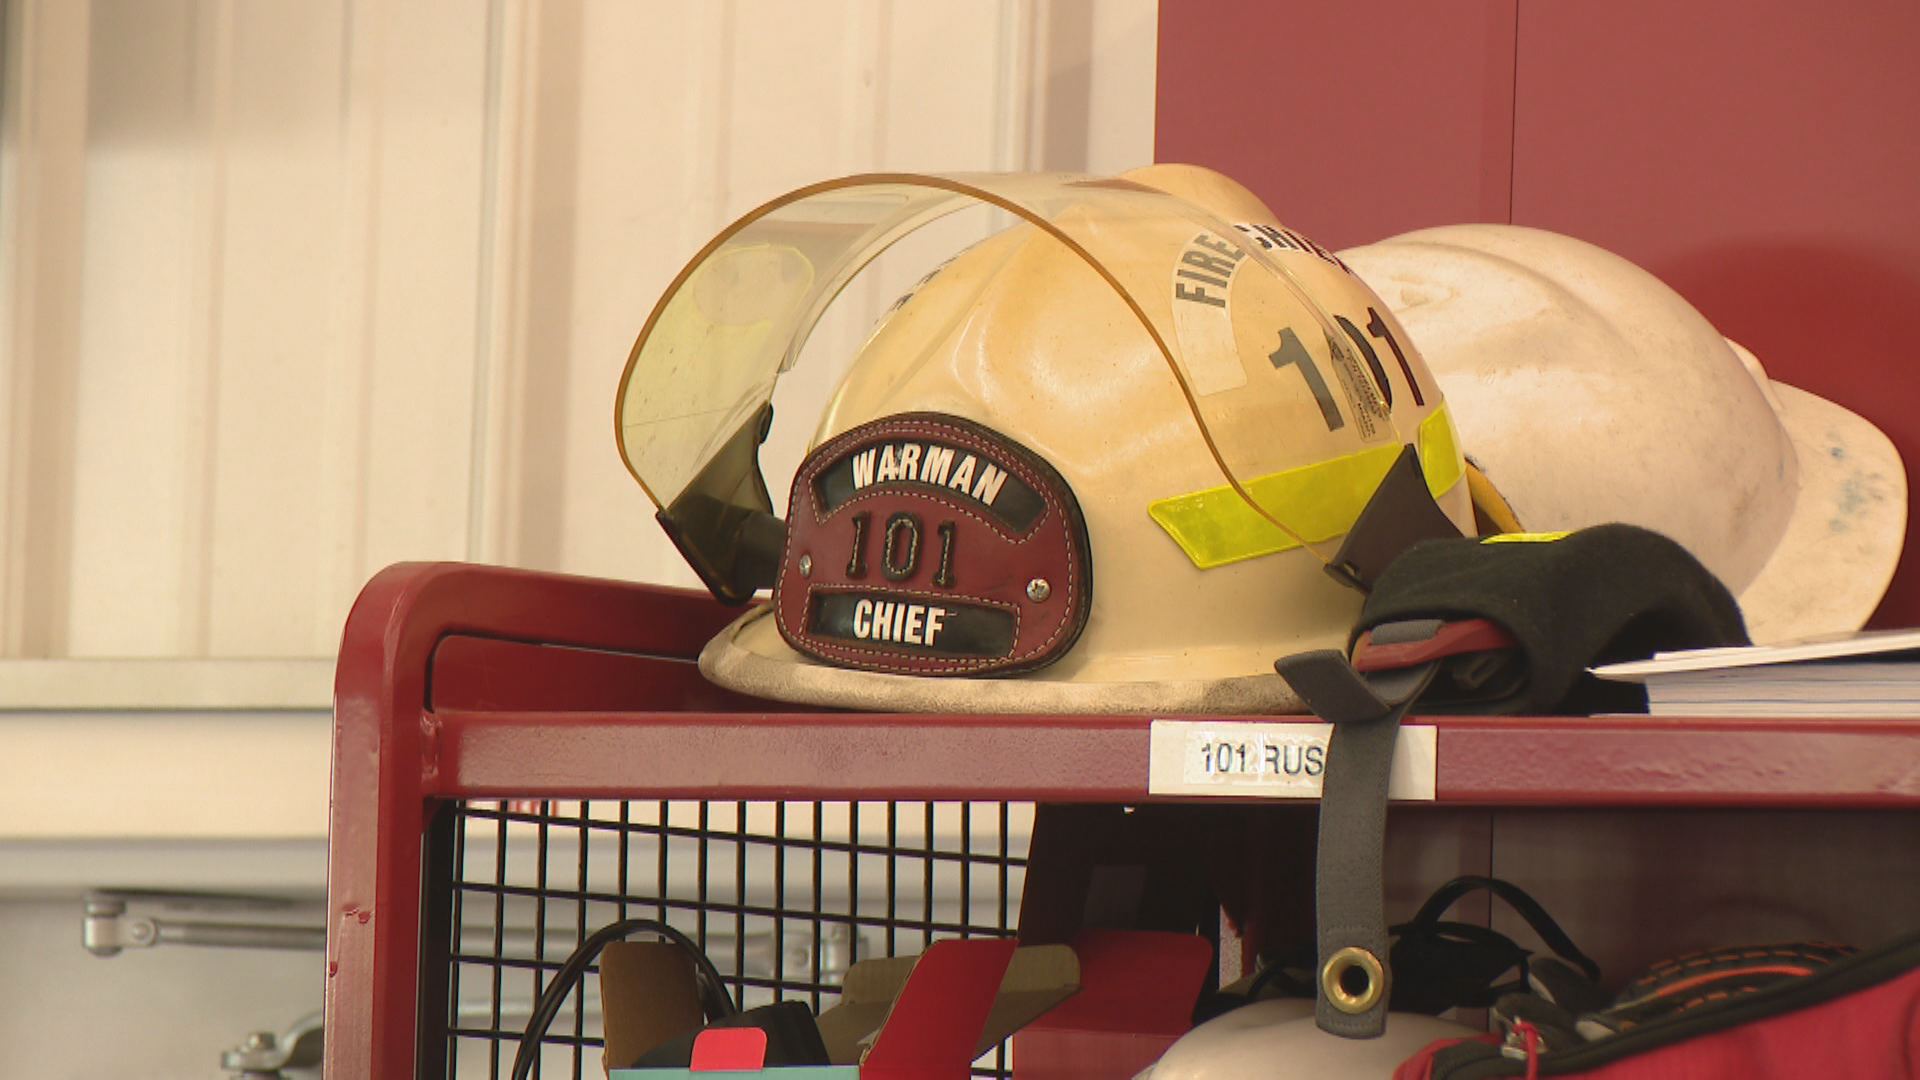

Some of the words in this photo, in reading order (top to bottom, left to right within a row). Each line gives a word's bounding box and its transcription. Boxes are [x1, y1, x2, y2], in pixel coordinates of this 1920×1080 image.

[1175, 233, 1247, 309] FIRE
[852, 442, 1008, 506] WARMAN
[846, 510, 957, 588] 101
[852, 598, 946, 647] CHIEF
[1201, 742, 1248, 773] 101
